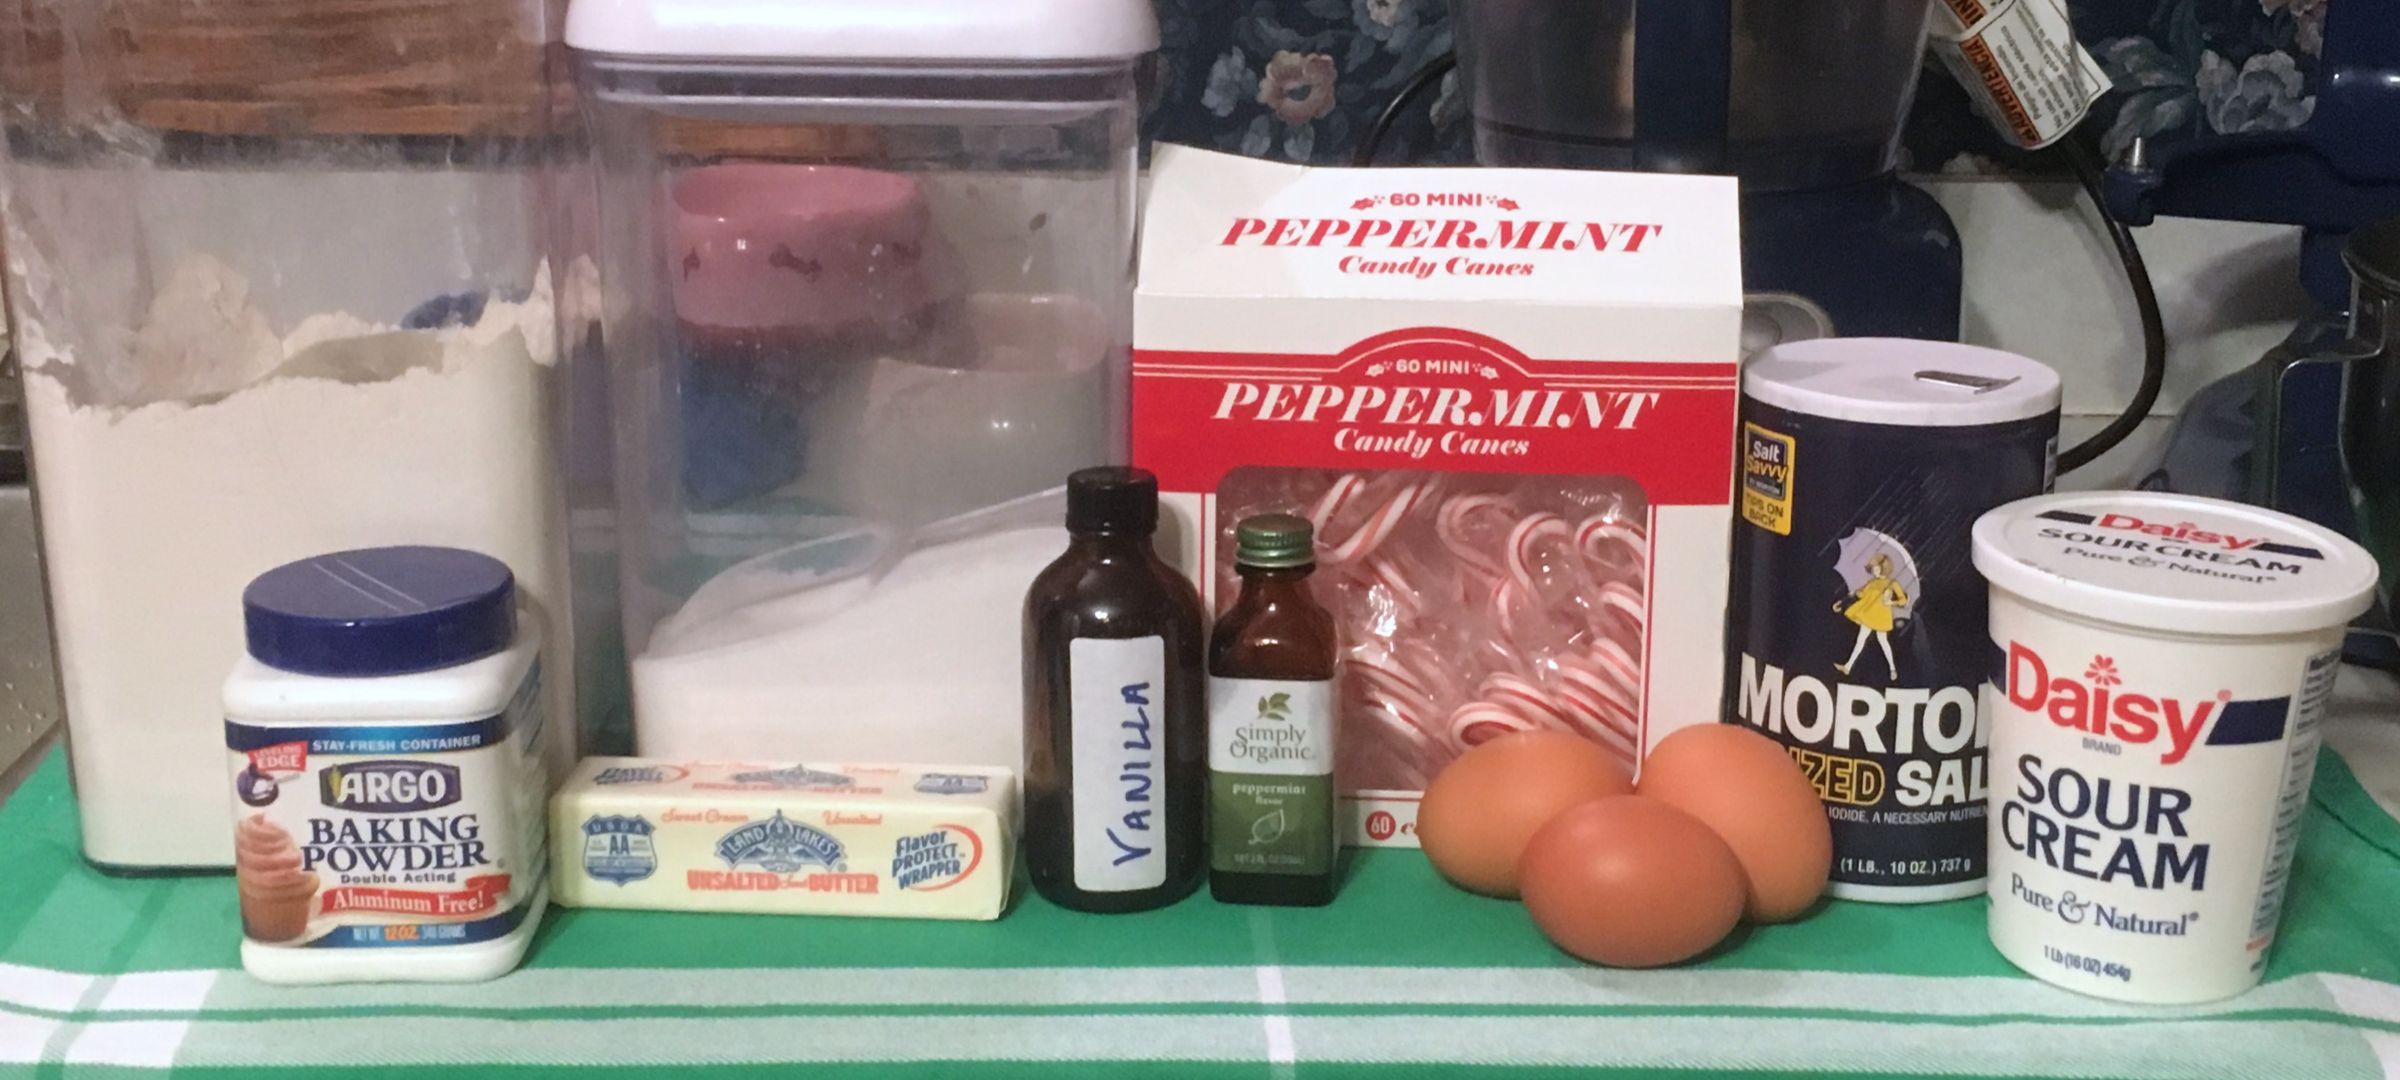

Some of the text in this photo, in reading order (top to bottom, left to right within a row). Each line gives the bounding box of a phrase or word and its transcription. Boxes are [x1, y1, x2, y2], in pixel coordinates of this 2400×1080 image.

[1965, 40, 2031, 132] ADVERTENCIA
[1389, 192, 1482, 207] 60 MINI
[1217, 217, 1663, 253] PEPPERMINT
[1338, 255, 1534, 279] Candy Canes
[1395, 359, 1470, 375] 60 MINI
[1211, 382, 1659, 430] PEPPERMINT
[1333, 428, 1530, 458] Candy Canes
[1753, 440, 1780, 462] Salt
[1747, 455, 1789, 483] Savvy
[1749, 508, 1776, 527] BACK
[1767, 503, 1784, 518] ON
[2098, 513, 2258, 550] Daisy
[2038, 528, 2302, 574] SOUR CREAM
[2063, 547, 2123, 562] Pure
[1738, 652, 1988, 755] MORTO
[2009, 639, 2217, 765] Daisy
[312, 734, 481, 751] STAY-FRESH CONTAINER
[1235, 723, 1306, 746] Simply
[2082, 736, 2122, 756] BRAND
[257, 753, 301, 769] EDGE
[1106, 682, 1152, 866] VANILLA
[337, 769, 446, 803] ARGO
[1233, 783, 1306, 795] peppermint
[1788, 746, 1885, 806] ZED
[1895, 756, 1988, 807] SAL
[2017, 753, 2193, 837] SOUR
[307, 814, 480, 844] BAKING
[1371, 816, 1390, 834] 60
[1872, 811, 1880, 824] A
[1884, 811, 1948, 825] NECESSARY
[610, 835, 630, 855] AA
[727, 825, 836, 855] LAND LAKES
[896, 831, 948, 857] Flavor
[2002, 801, 2210, 891] CREAM
[300, 840, 491, 872] POWDER
[892, 843, 958, 878] PROTECT
[1840, 857, 1853, 873] (1
[1890, 861, 1905, 875] 10
[1940, 857, 1961, 873] 737
[341, 873, 456, 884] Double Acting
[687, 870, 780, 891] UNSALTED
[809, 873, 879, 893] BUTTER
[898, 860, 960, 890] WRAPPER
[333, 890, 484, 913] Aluminum Free!
[2011, 872, 2054, 912] Pure
[2057, 890, 2090, 924] &
[2044, 945, 2049, 958] 1
[2051, 947, 2063, 964] Lb
[2103, 962, 2131, 982] 454g
